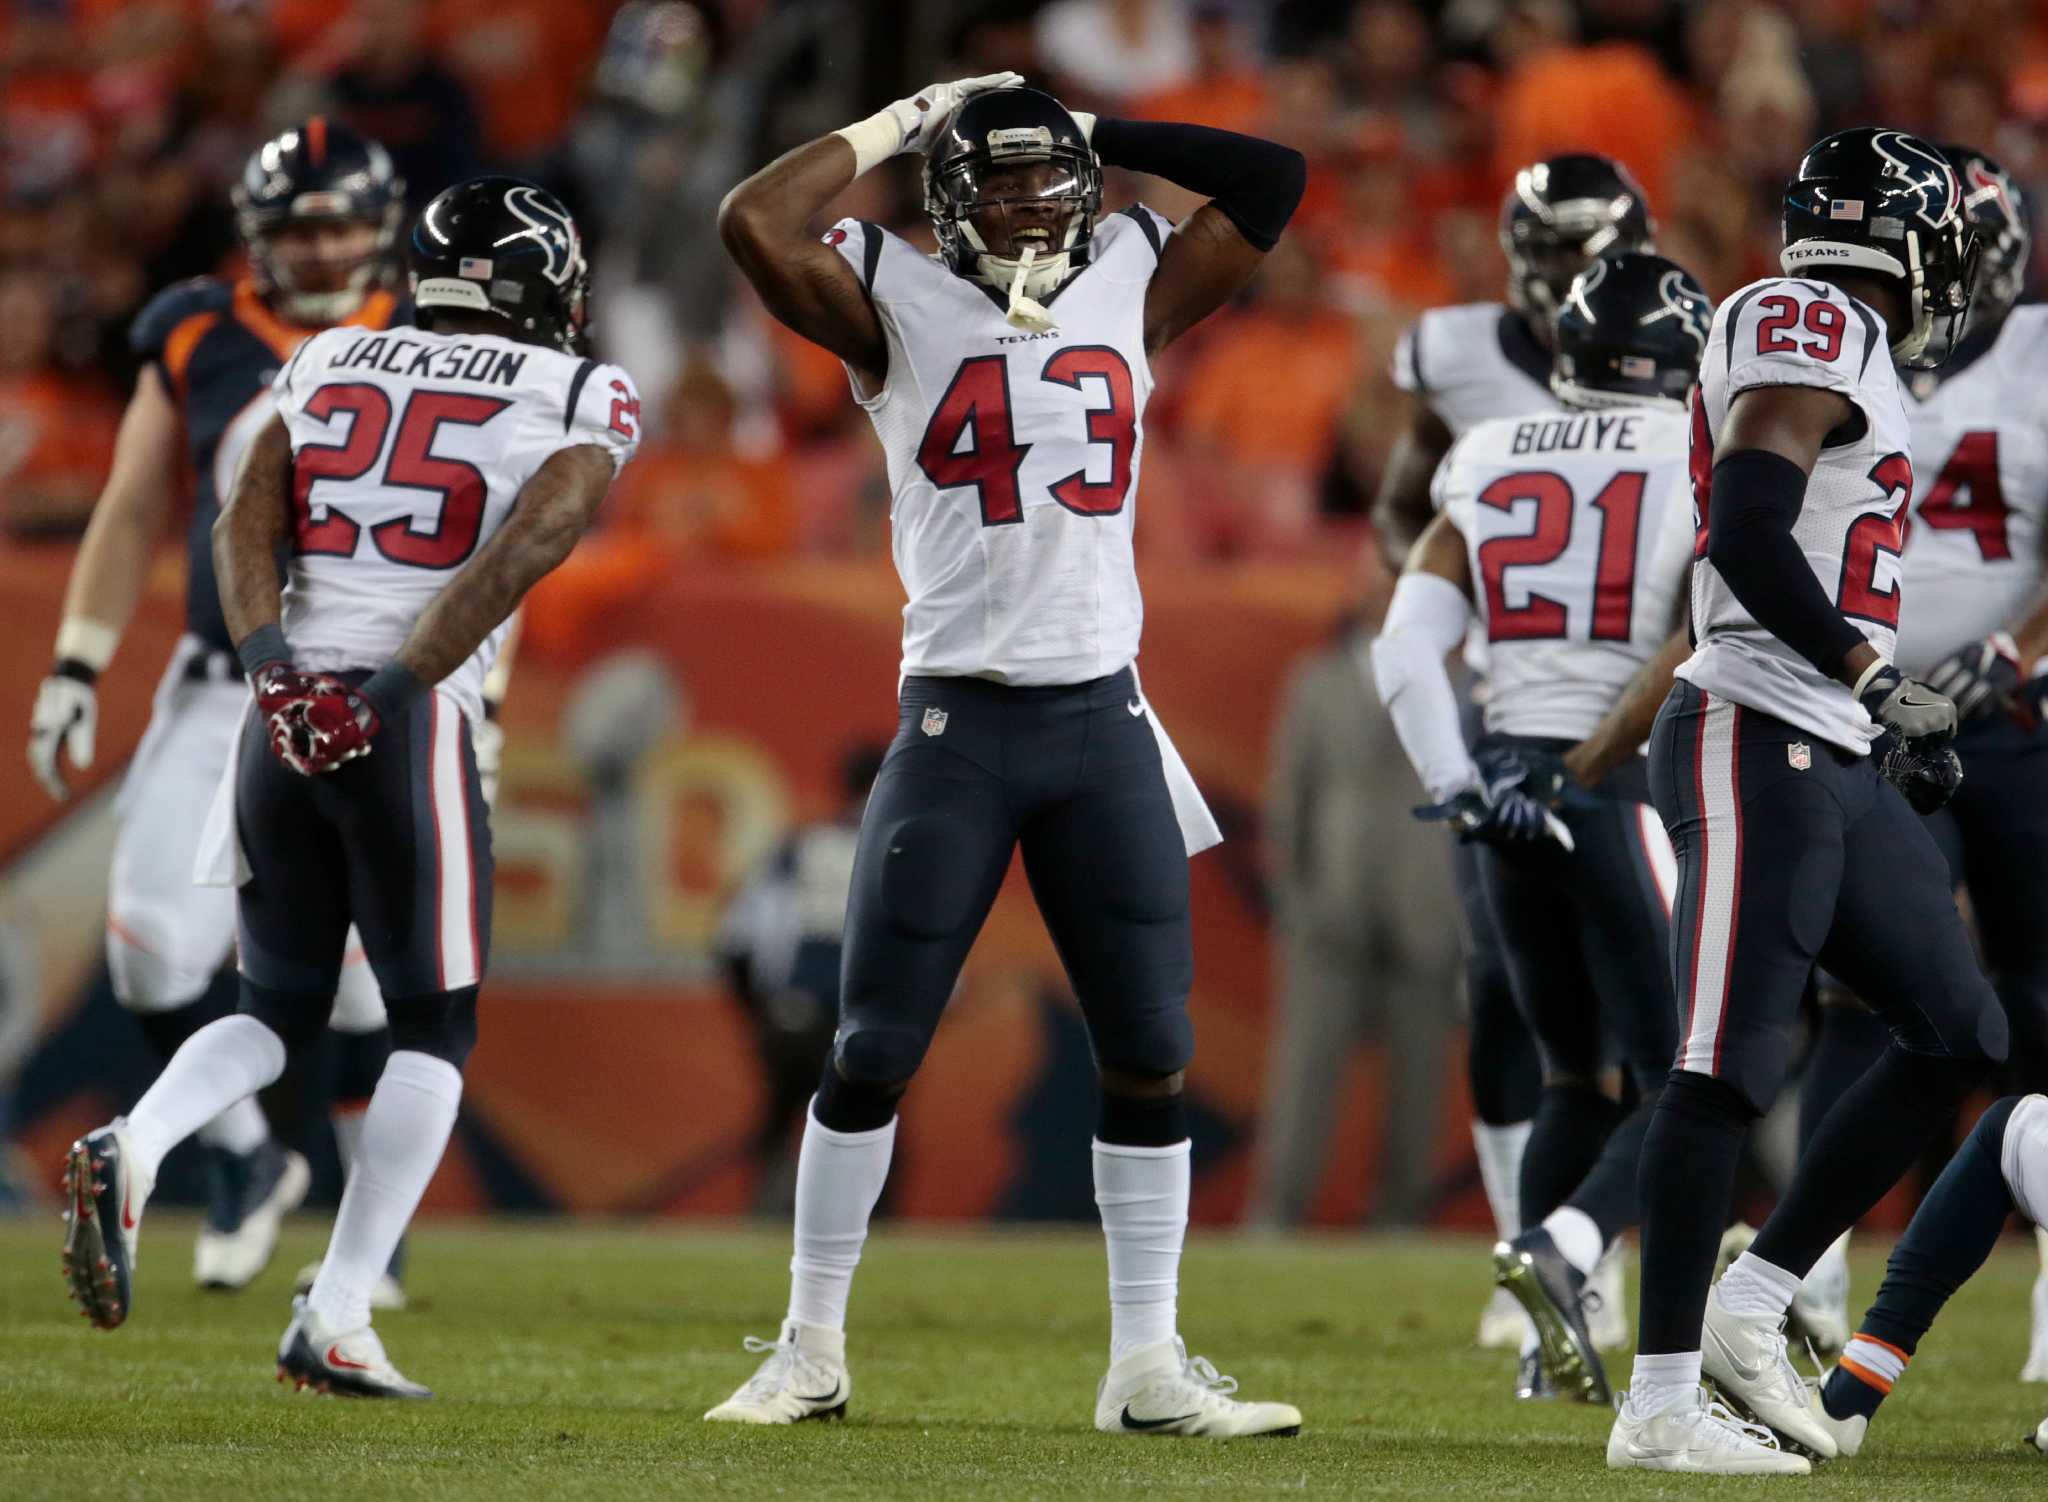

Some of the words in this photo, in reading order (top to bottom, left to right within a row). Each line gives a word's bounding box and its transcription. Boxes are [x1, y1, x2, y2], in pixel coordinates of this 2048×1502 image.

[1787, 248, 1850, 261] TEXANS
[994, 331, 1060, 345] TEXANS
[1757, 295, 1846, 363] 29
[328, 337, 527, 387] JACKSON
[608, 379, 640, 440] 2
[915, 344, 1137, 528] 43
[1511, 415, 1646, 456] BOUYE
[293, 382, 516, 571] 25
[1900, 430, 2022, 564] 4
[1477, 470, 1649, 644] 21
